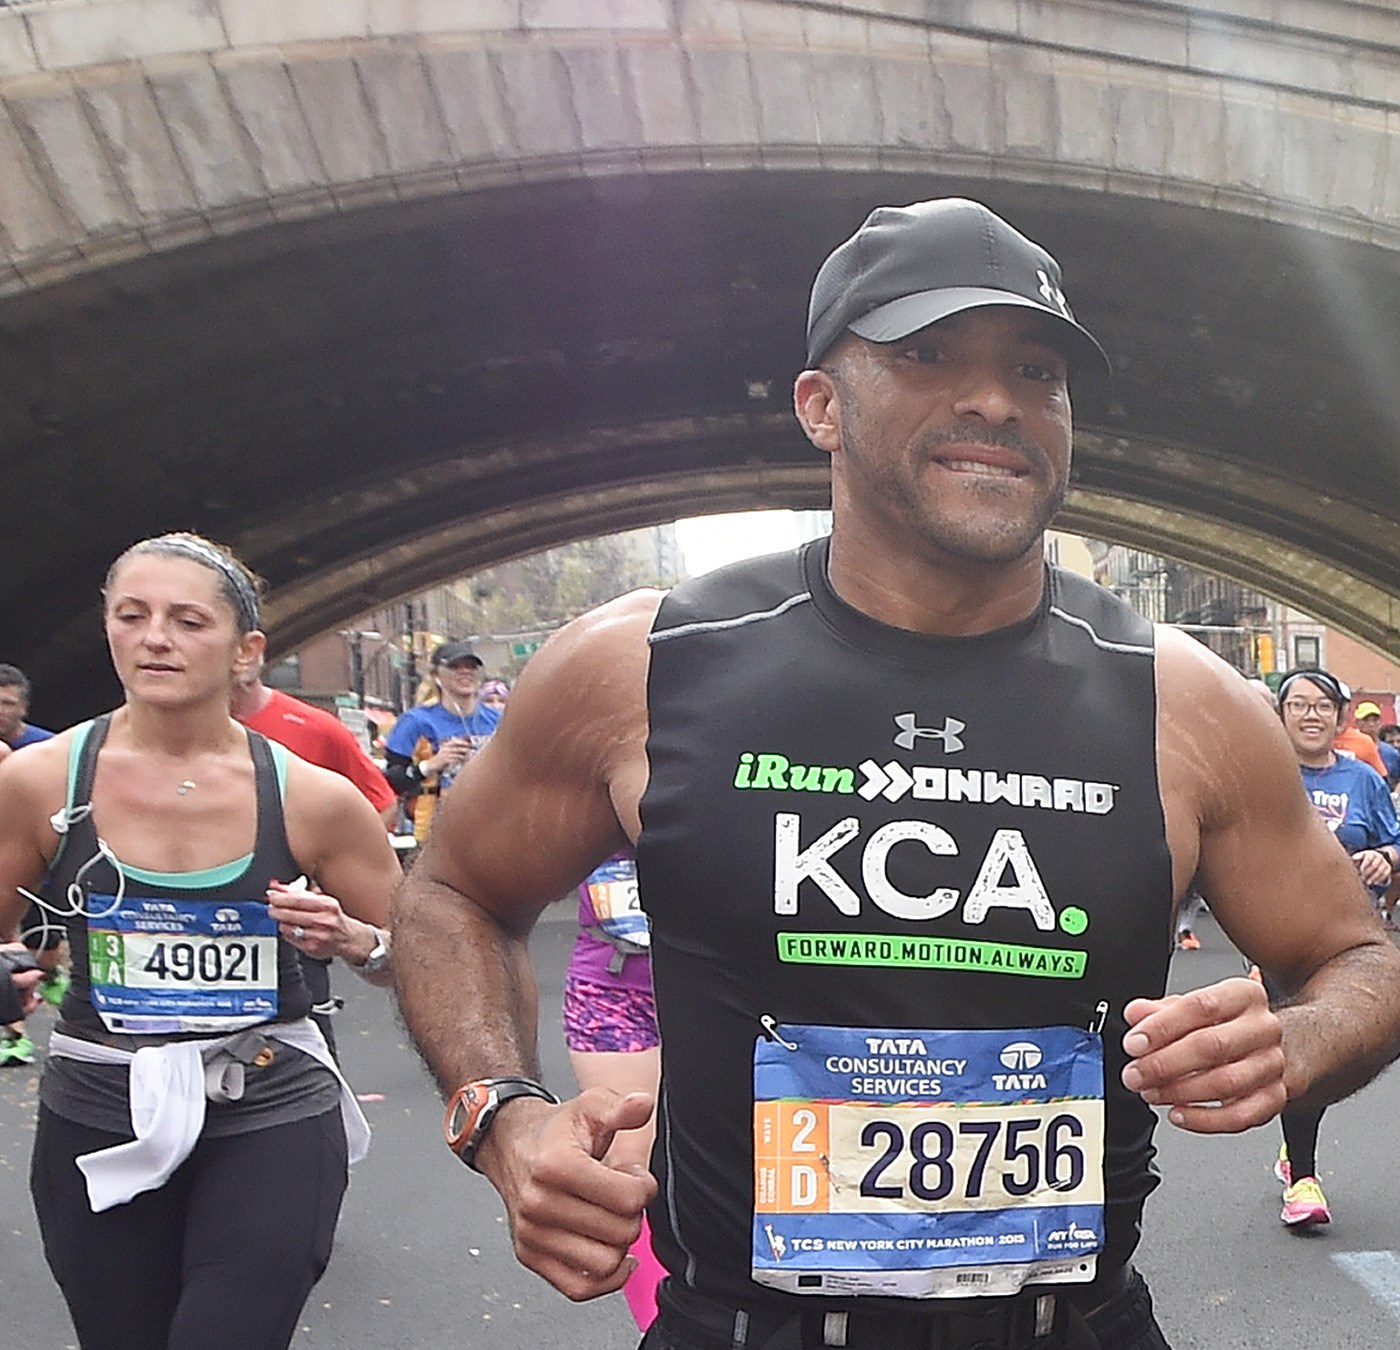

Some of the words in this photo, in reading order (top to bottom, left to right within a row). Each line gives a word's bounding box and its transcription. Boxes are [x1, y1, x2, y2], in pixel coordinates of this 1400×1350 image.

[734, 752, 856, 795] iRun
[912, 766, 1116, 815] ONWARD
[774, 812, 1089, 936] KCA.
[106, 936, 119, 957] 3
[108, 961, 122, 986] A
[144, 942, 260, 983] 49021
[865, 1038, 928, 1056] TATA
[826, 1056, 967, 1077] CONSULTANCY
[851, 1078, 942, 1096] SERVICES
[992, 1074, 1047, 1091] TATA
[791, 1109, 818, 1152] 2
[859, 1114, 1085, 1200] 28756
[791, 1165, 818, 1206] D
[791, 1238, 824, 1251] TCS
[826, 1240, 858, 1251] NEW
[859, 1240, 894, 1250] YORK
[896, 1239, 924, 1250] CITY
[926, 1235, 994, 1248] MARATHON
